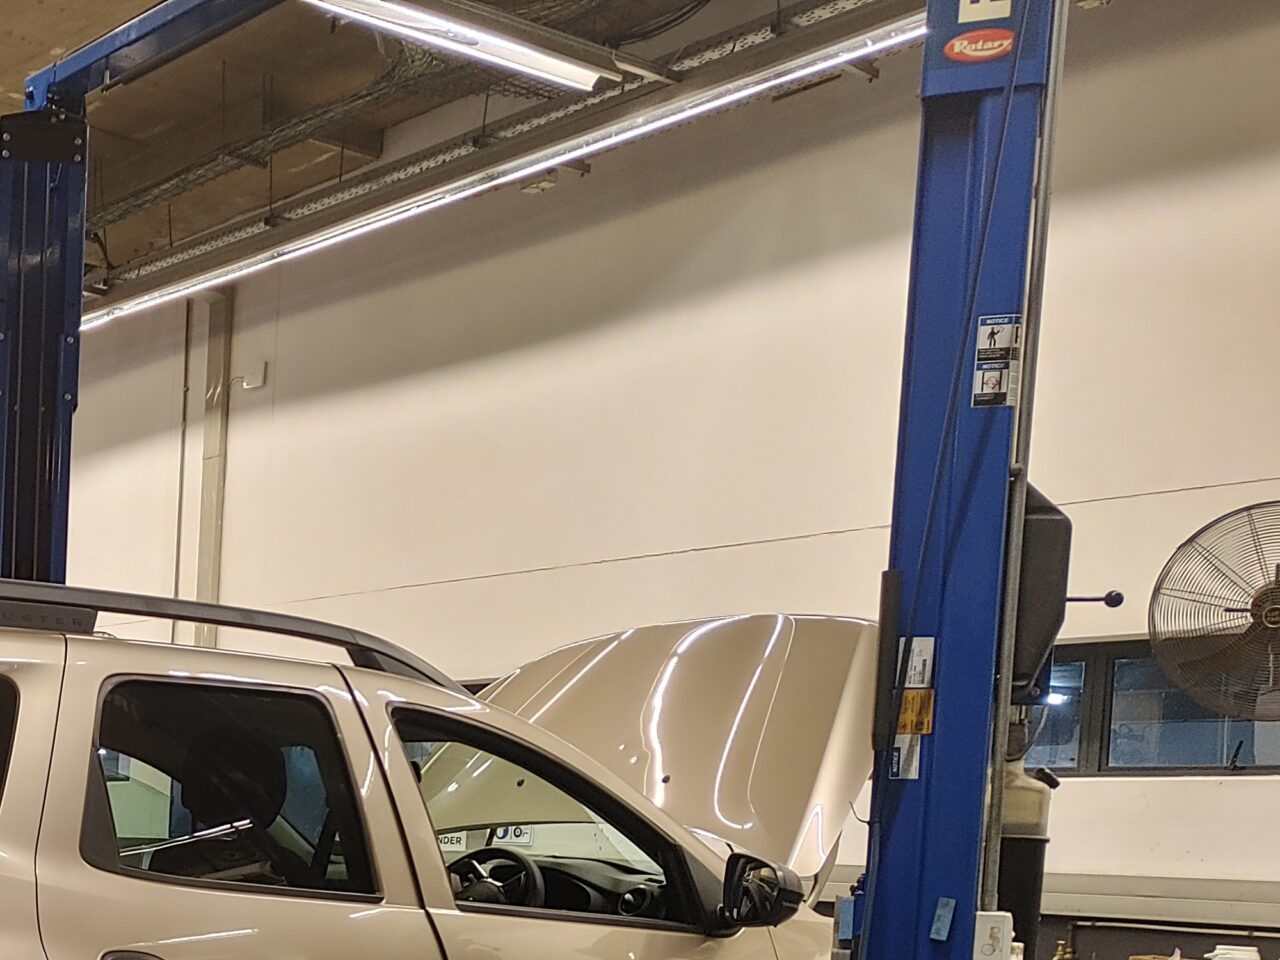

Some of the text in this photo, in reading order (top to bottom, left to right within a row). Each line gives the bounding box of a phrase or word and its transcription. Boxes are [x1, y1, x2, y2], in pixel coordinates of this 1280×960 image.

[953, 38, 1013, 57] Rotary
[986, 317, 1009, 325] NOTICE
[438, 836, 461, 845] NDER
